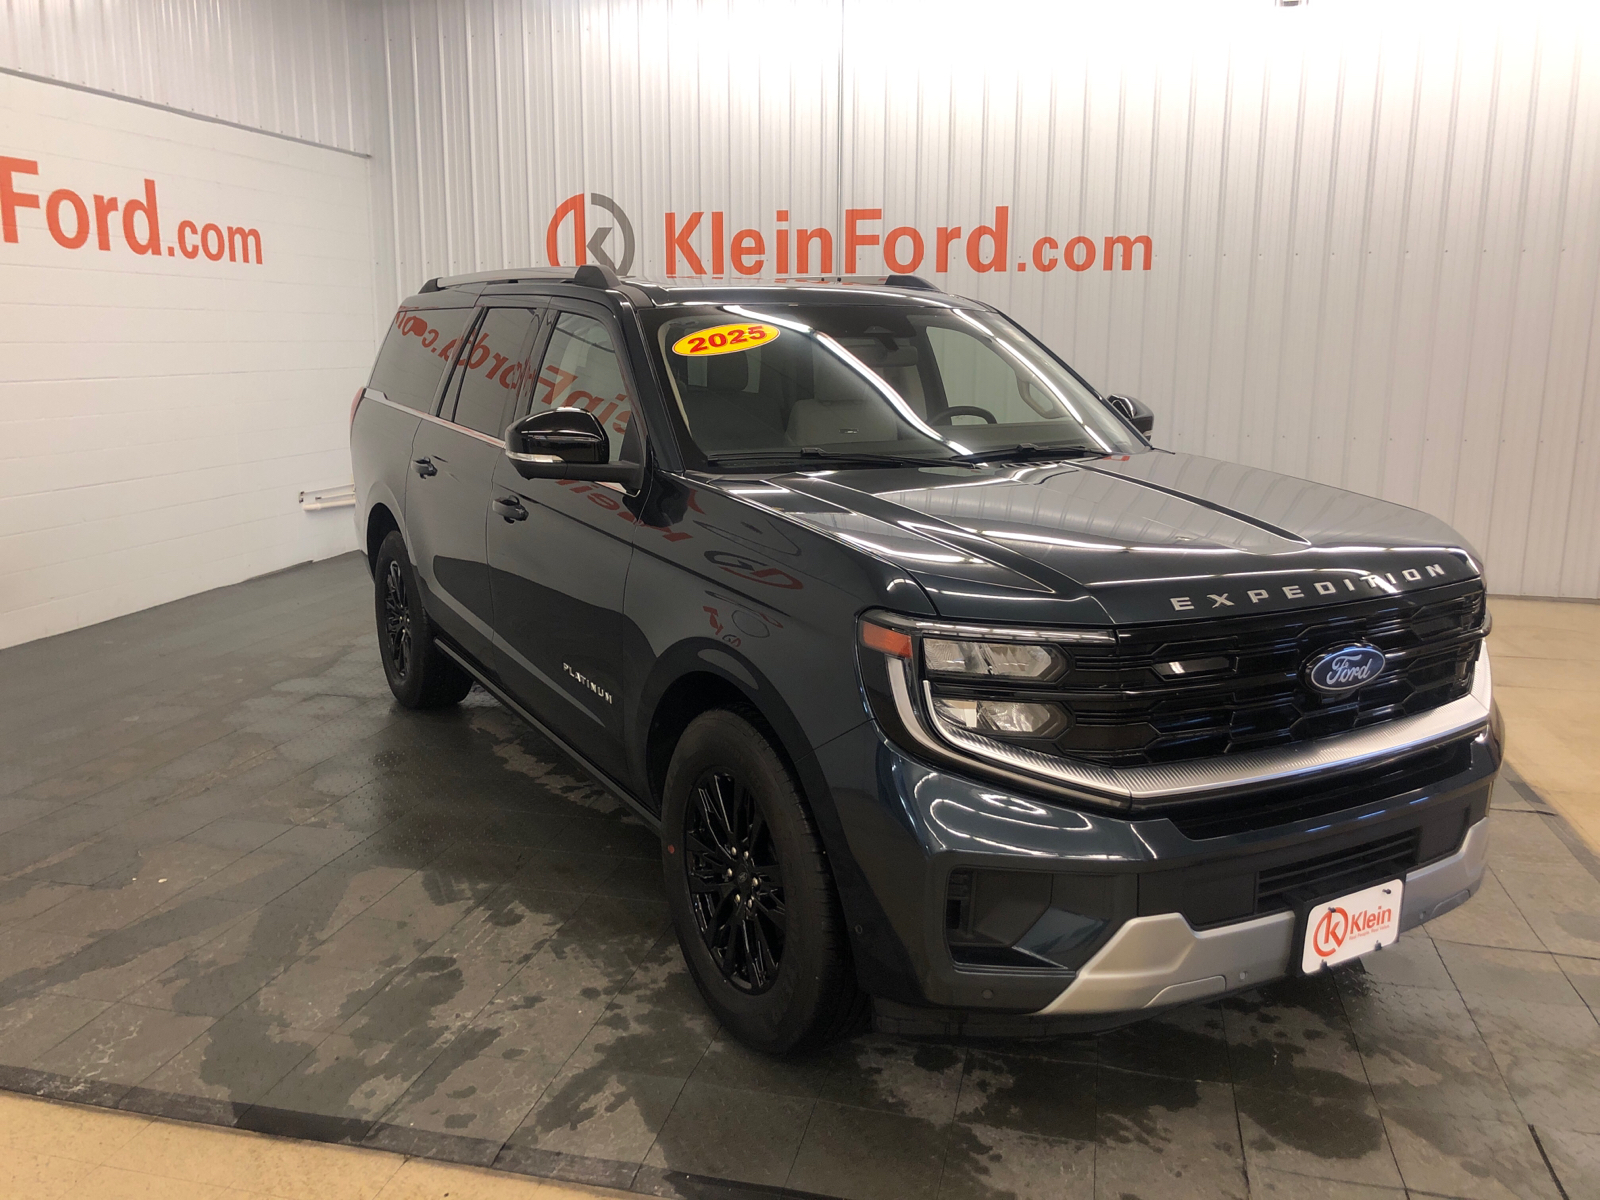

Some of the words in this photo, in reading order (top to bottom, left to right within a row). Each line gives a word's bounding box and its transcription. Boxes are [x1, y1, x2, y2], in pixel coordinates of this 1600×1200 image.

[664, 206, 1152, 277] KleinFord.com
[687, 325, 768, 353] 2025
[1170, 563, 1445, 611] EXPEDITION
[562, 662, 612, 704] PLATINUM
[1326, 653, 1371, 685] Ford
[1350, 905, 1391, 935] Klein
